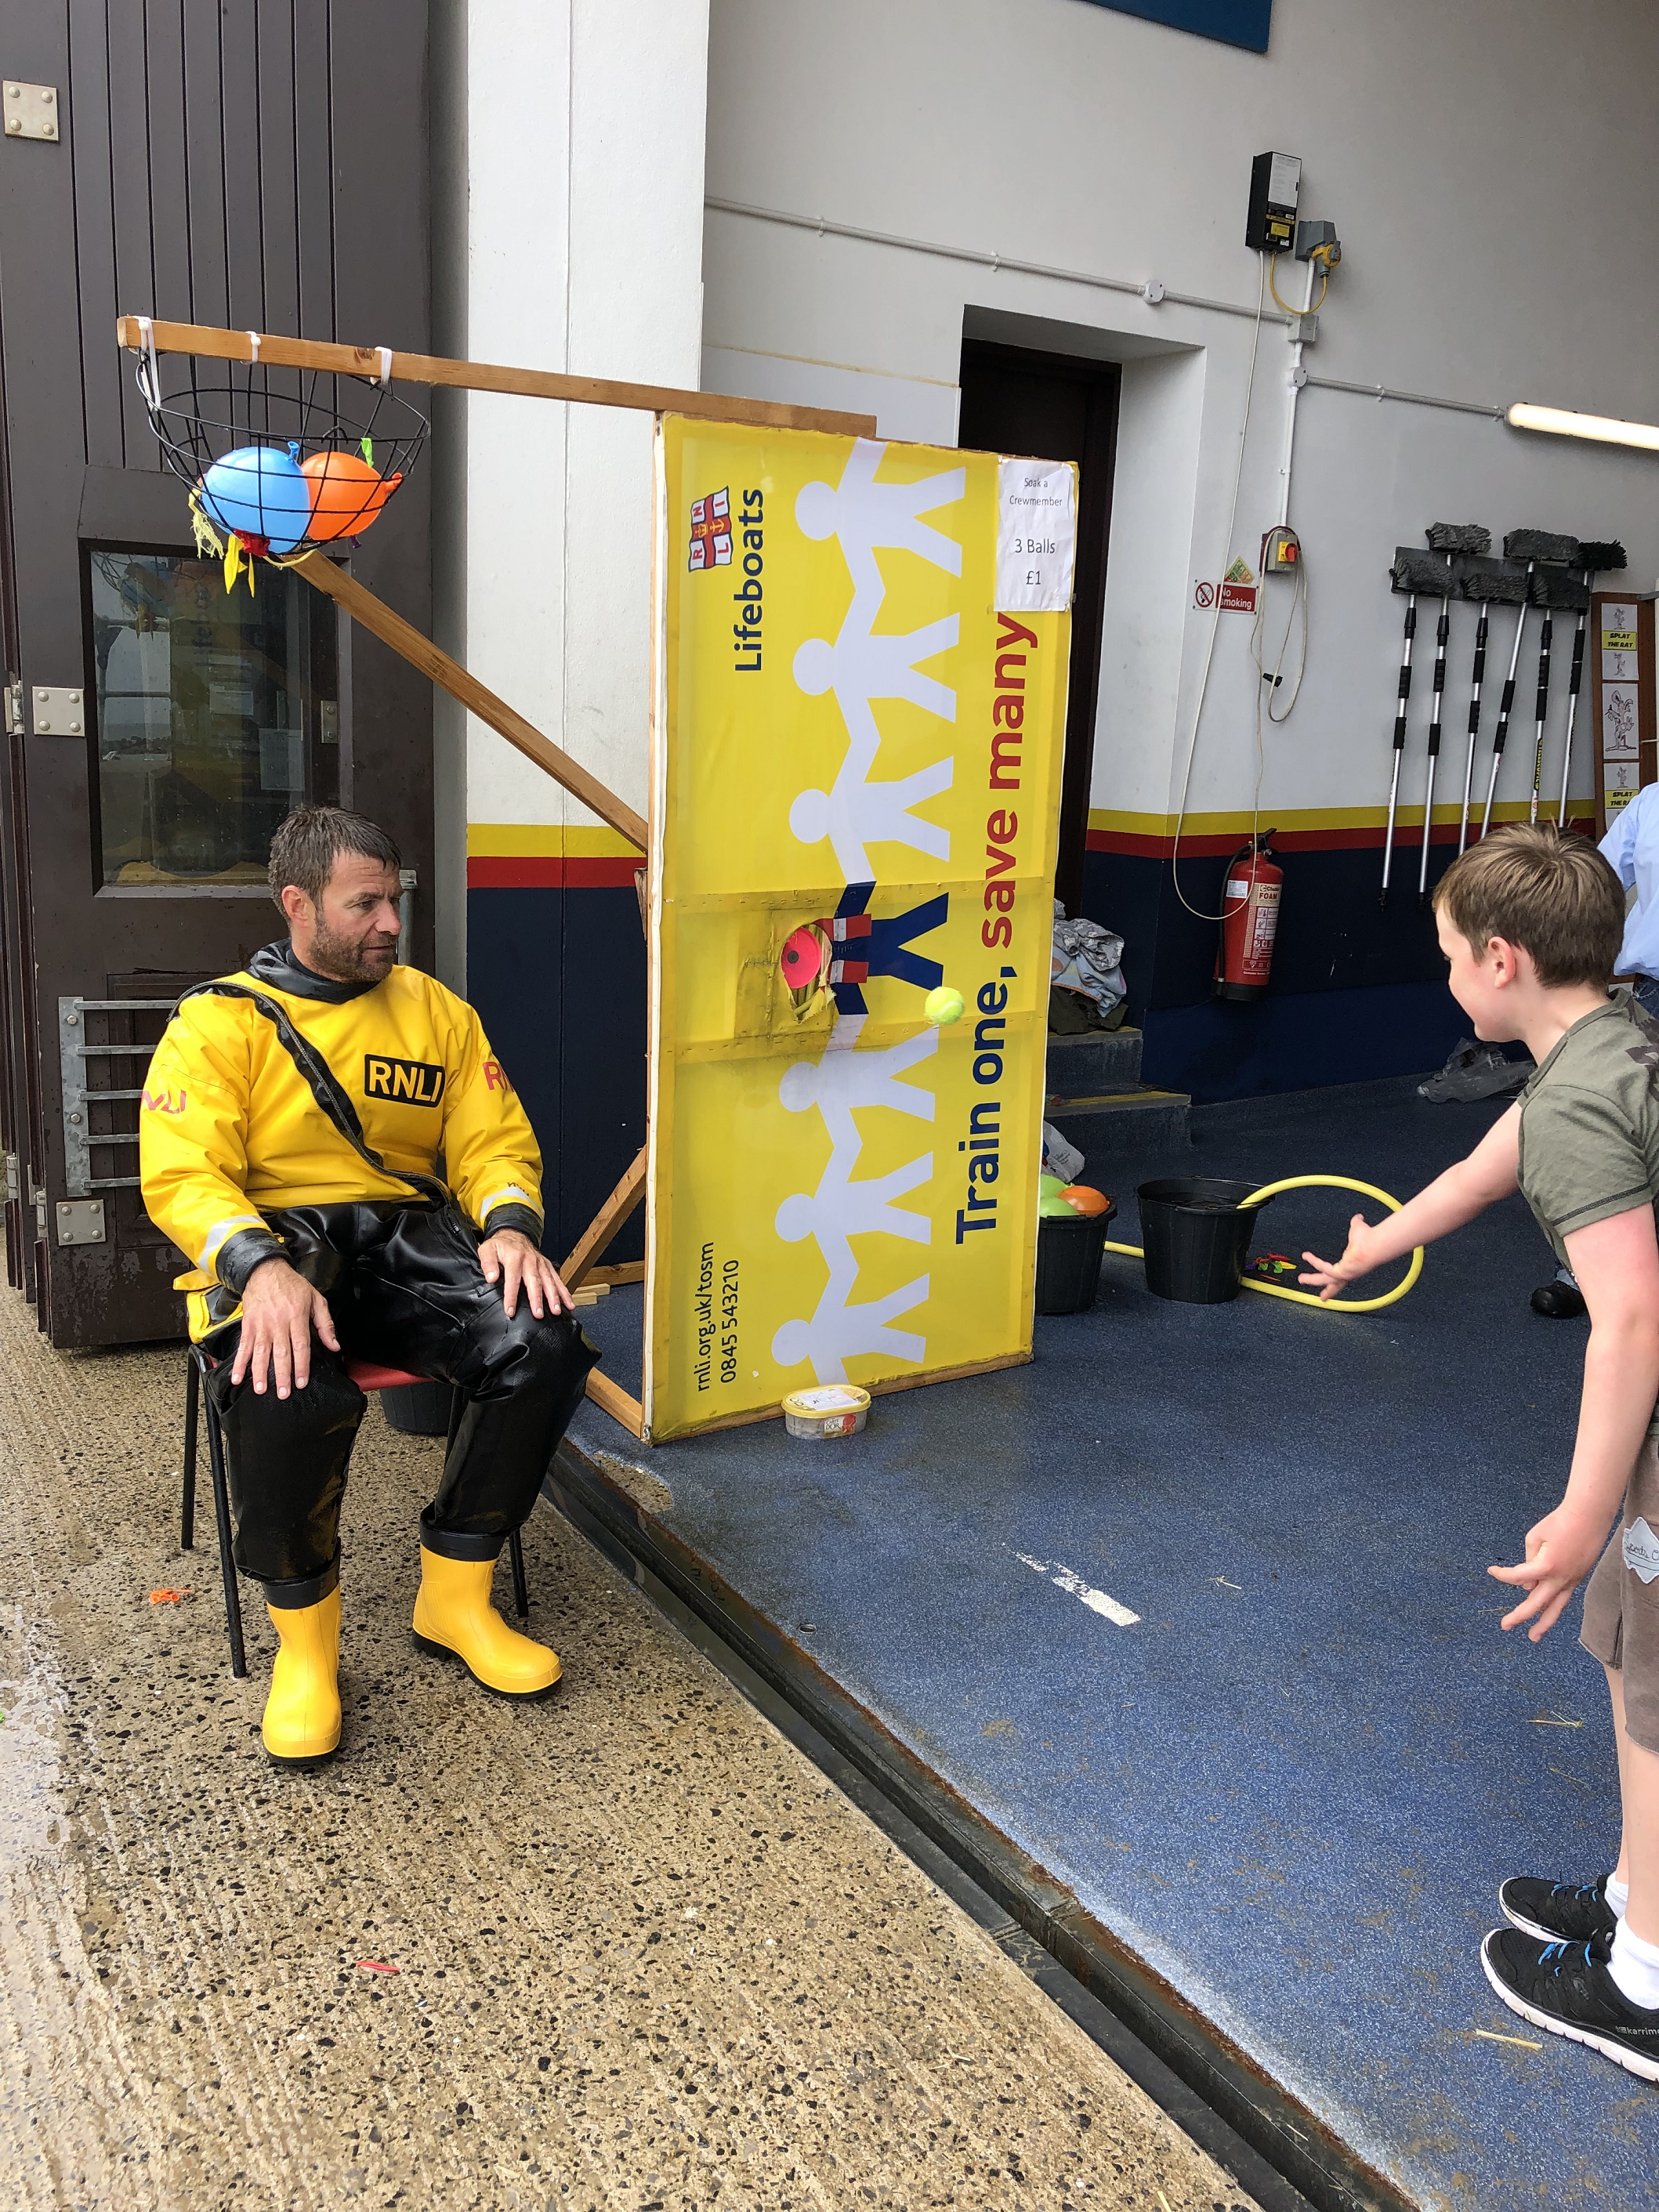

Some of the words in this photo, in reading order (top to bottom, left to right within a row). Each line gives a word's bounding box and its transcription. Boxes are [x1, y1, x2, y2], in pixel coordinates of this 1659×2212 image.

[1009, 494, 1063, 506] Crewmember
[1023, 477, 1041, 488] Soak
[1043, 480, 1049, 488] a
[1014, 538, 1023, 553] 3
[1027, 538, 1056, 554] Balls
[733, 488, 764, 672] Lifeboats
[1025, 570, 1041, 585] £1
[1221, 588, 1231, 597] No
[1220, 597, 1252, 610] smoking
[989, 612, 1038, 790] many
[981, 808, 1019, 950] save
[972, 965, 1019, 1086] one,
[141, 1089, 187, 1113] NLI
[369, 1059, 443, 1102] RNLI
[955, 1102, 1001, 1244] Train
[693, 1240, 716, 1392] rnli.org.uk/tosm
[721, 1258, 740, 1330] 543210
[719, 1334, 738, 1384] 0845
